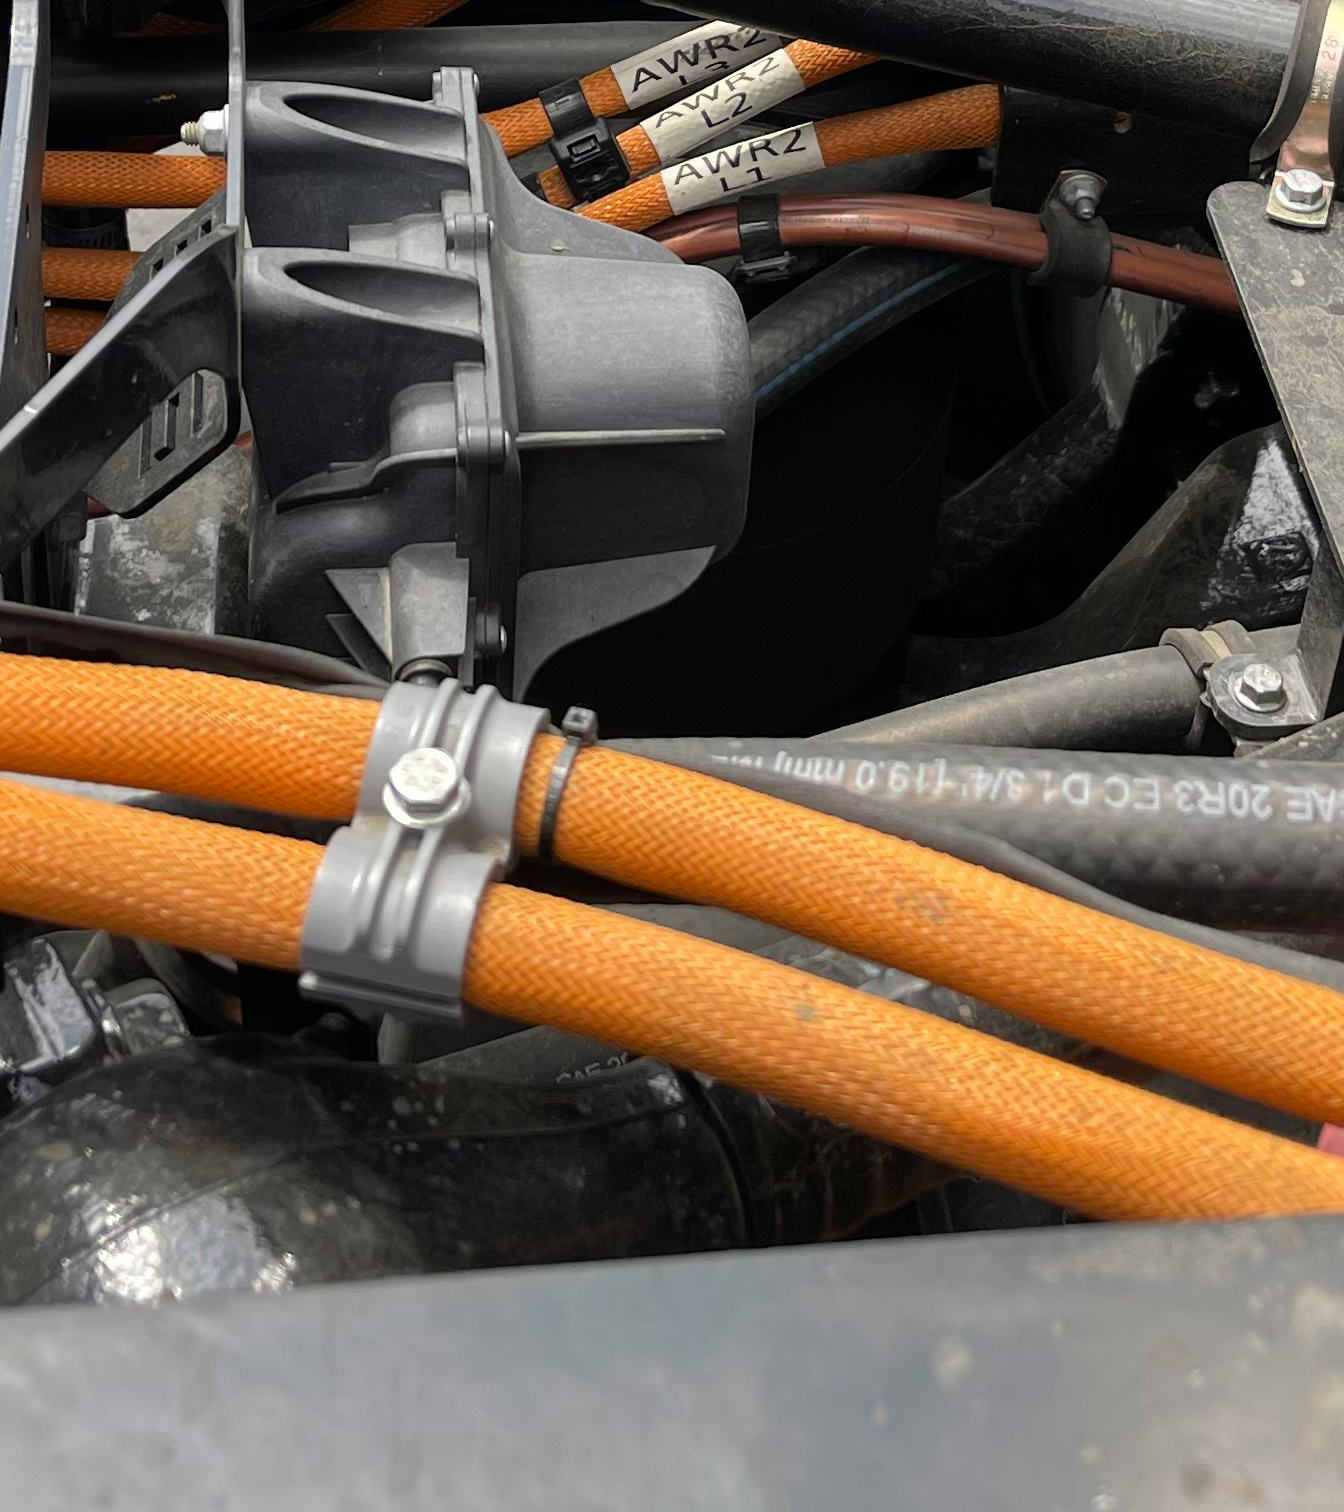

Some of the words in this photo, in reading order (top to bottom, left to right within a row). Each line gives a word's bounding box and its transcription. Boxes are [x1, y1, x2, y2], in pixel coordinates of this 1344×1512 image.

[655, 56, 780, 129] AWR2
[700, 91, 753, 128] L2
[674, 128, 807, 186] AWR2
[719, 166, 772, 193] L1
[1104, 773, 1161, 811] EC
[1173, 778, 1274, 821] 20R3
